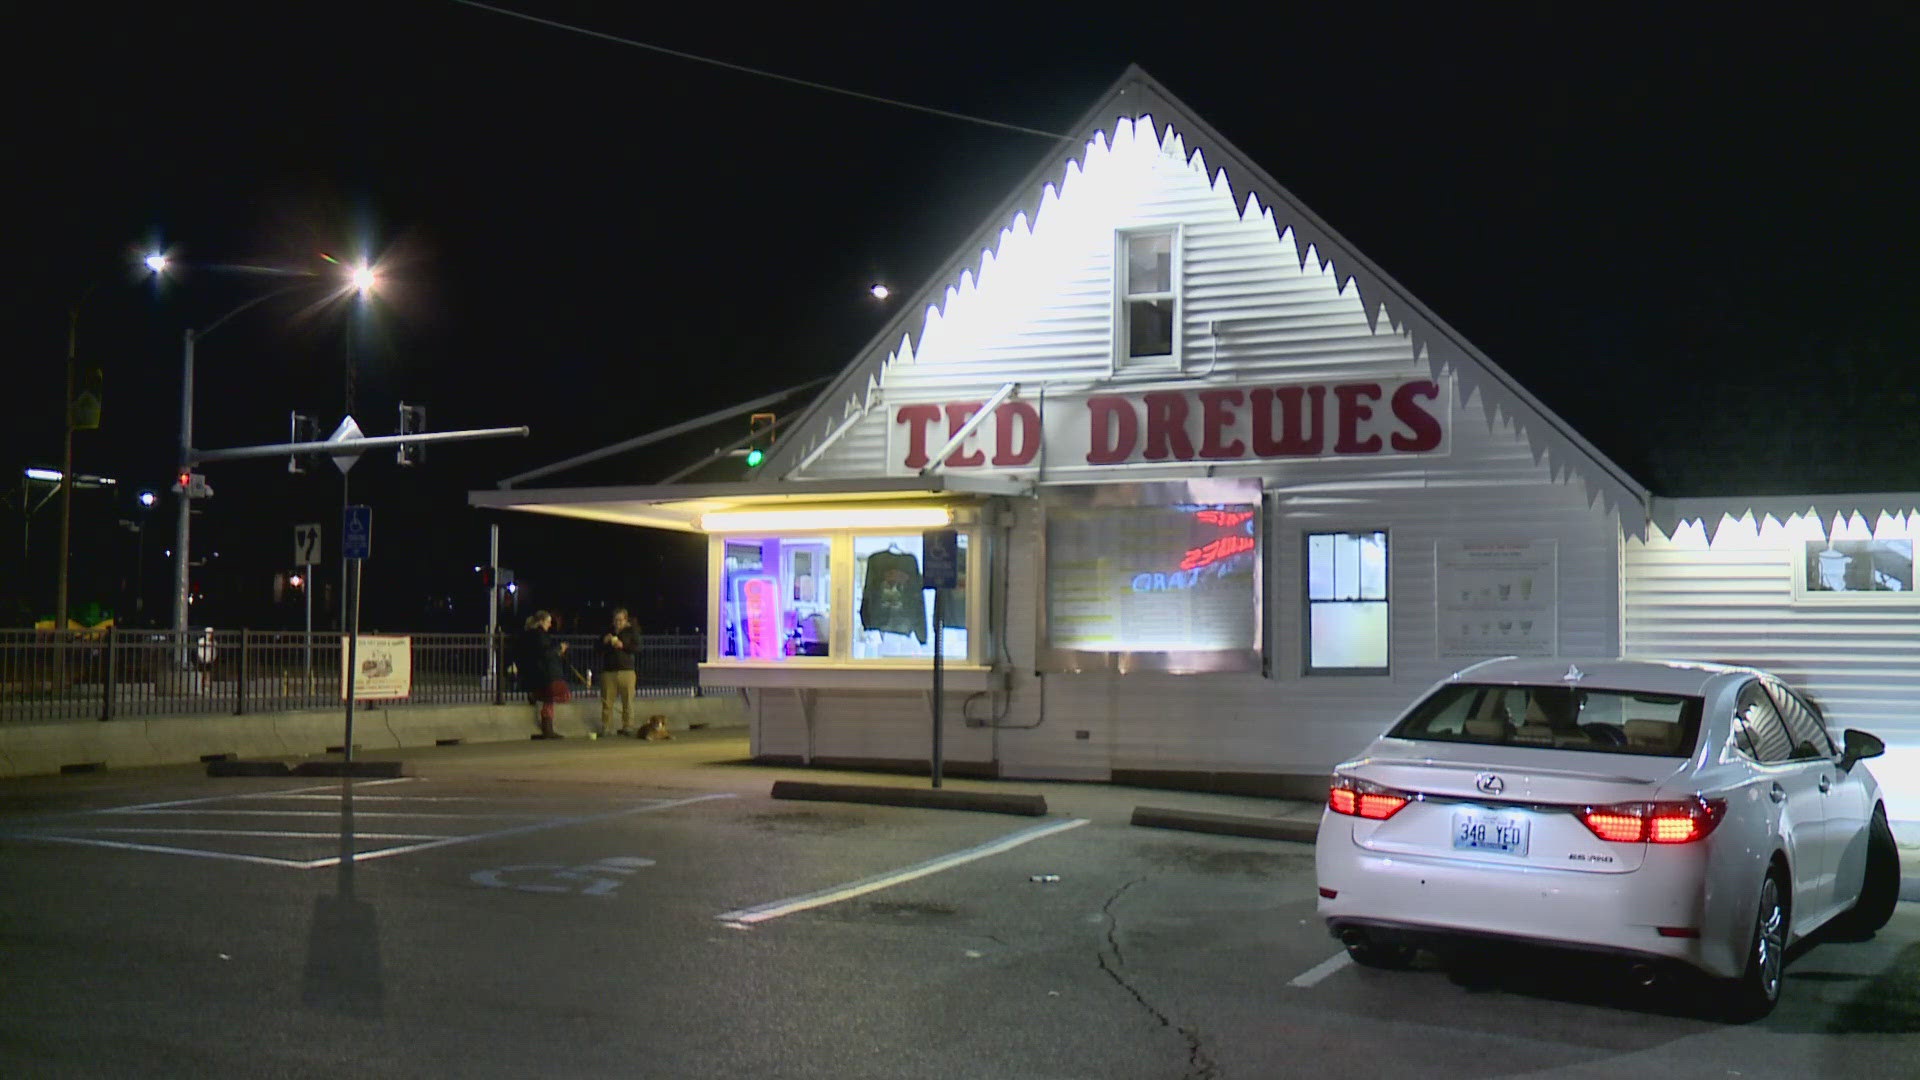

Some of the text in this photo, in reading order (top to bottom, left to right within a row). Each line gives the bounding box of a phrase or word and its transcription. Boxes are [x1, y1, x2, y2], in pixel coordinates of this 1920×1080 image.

[896, 380, 1442, 469] TED DREWES
[1461, 823, 1486, 842] 348
